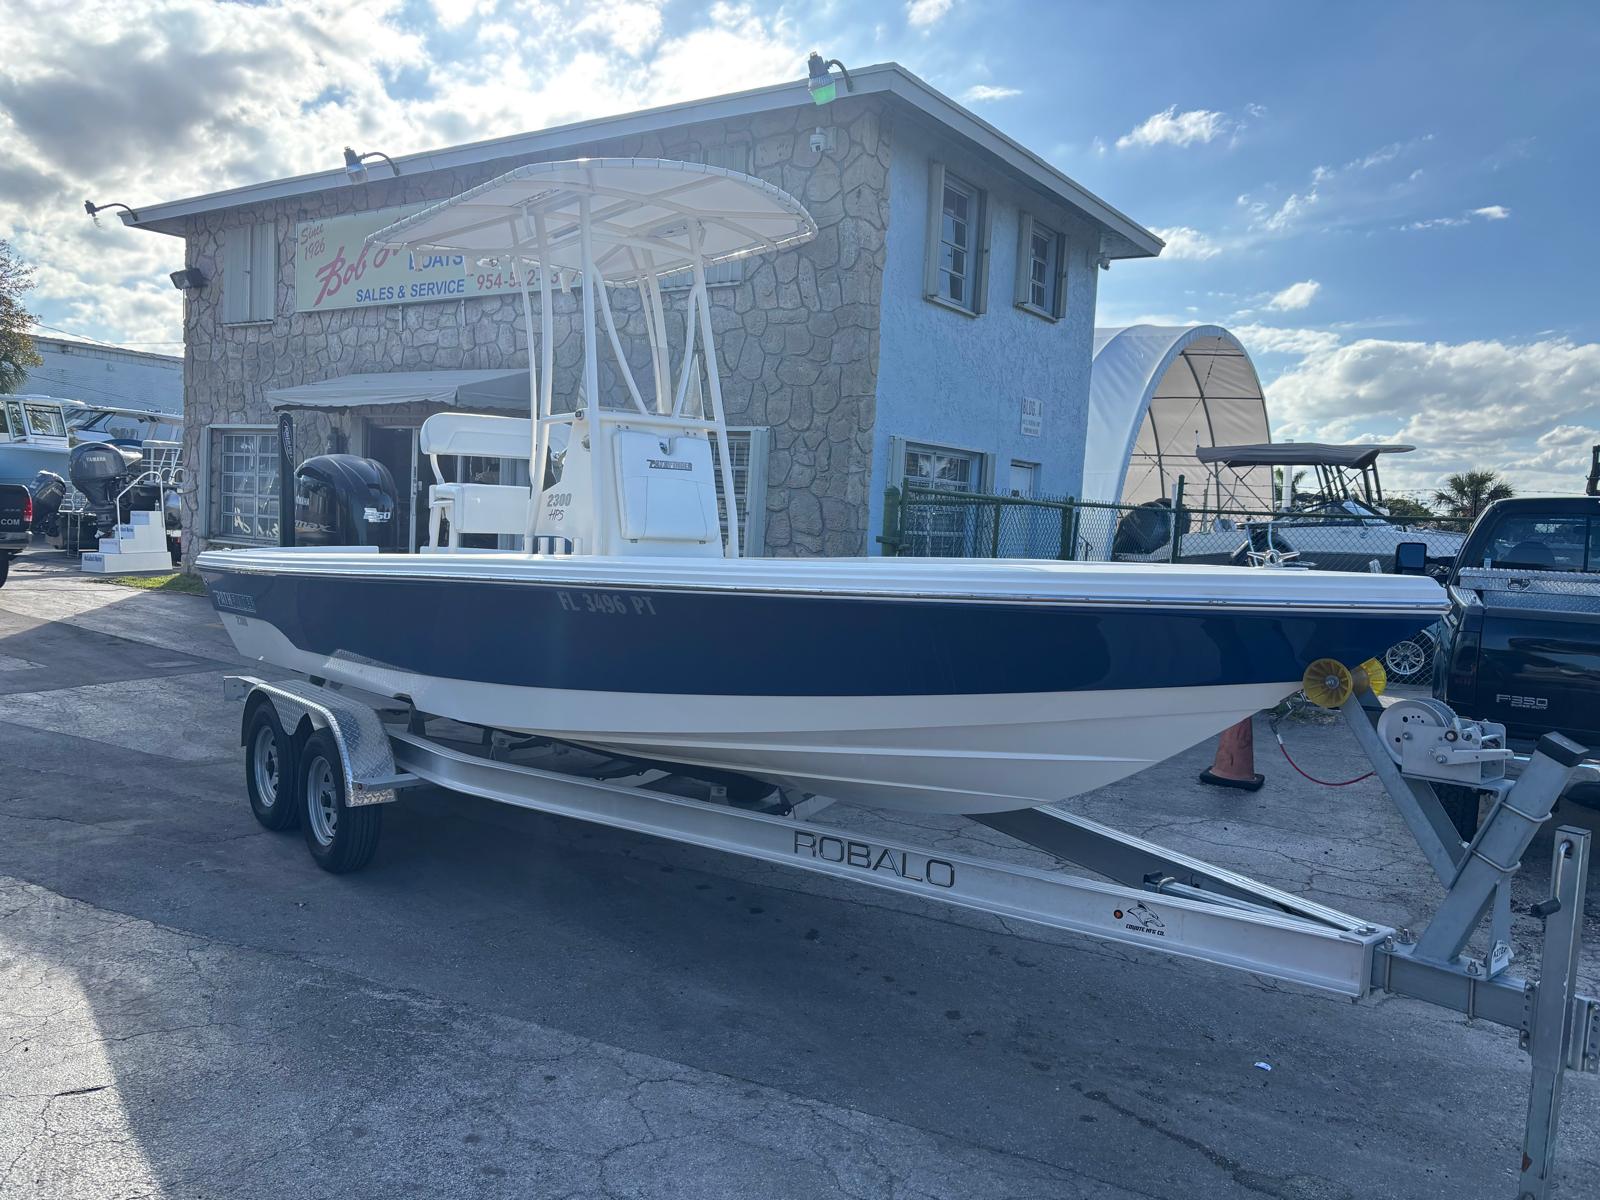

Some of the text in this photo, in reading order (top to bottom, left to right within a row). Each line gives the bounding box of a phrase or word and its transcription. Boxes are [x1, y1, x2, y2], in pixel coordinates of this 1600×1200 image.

[301, 224, 324, 245] Since
[356, 278, 465, 302] SALES & SERVICE
[547, 493, 572, 507] 2300
[548, 509, 565, 521] HPS
[557, 591, 656, 615] FL 3496 PT
[794, 831, 955, 888] ROBALO
